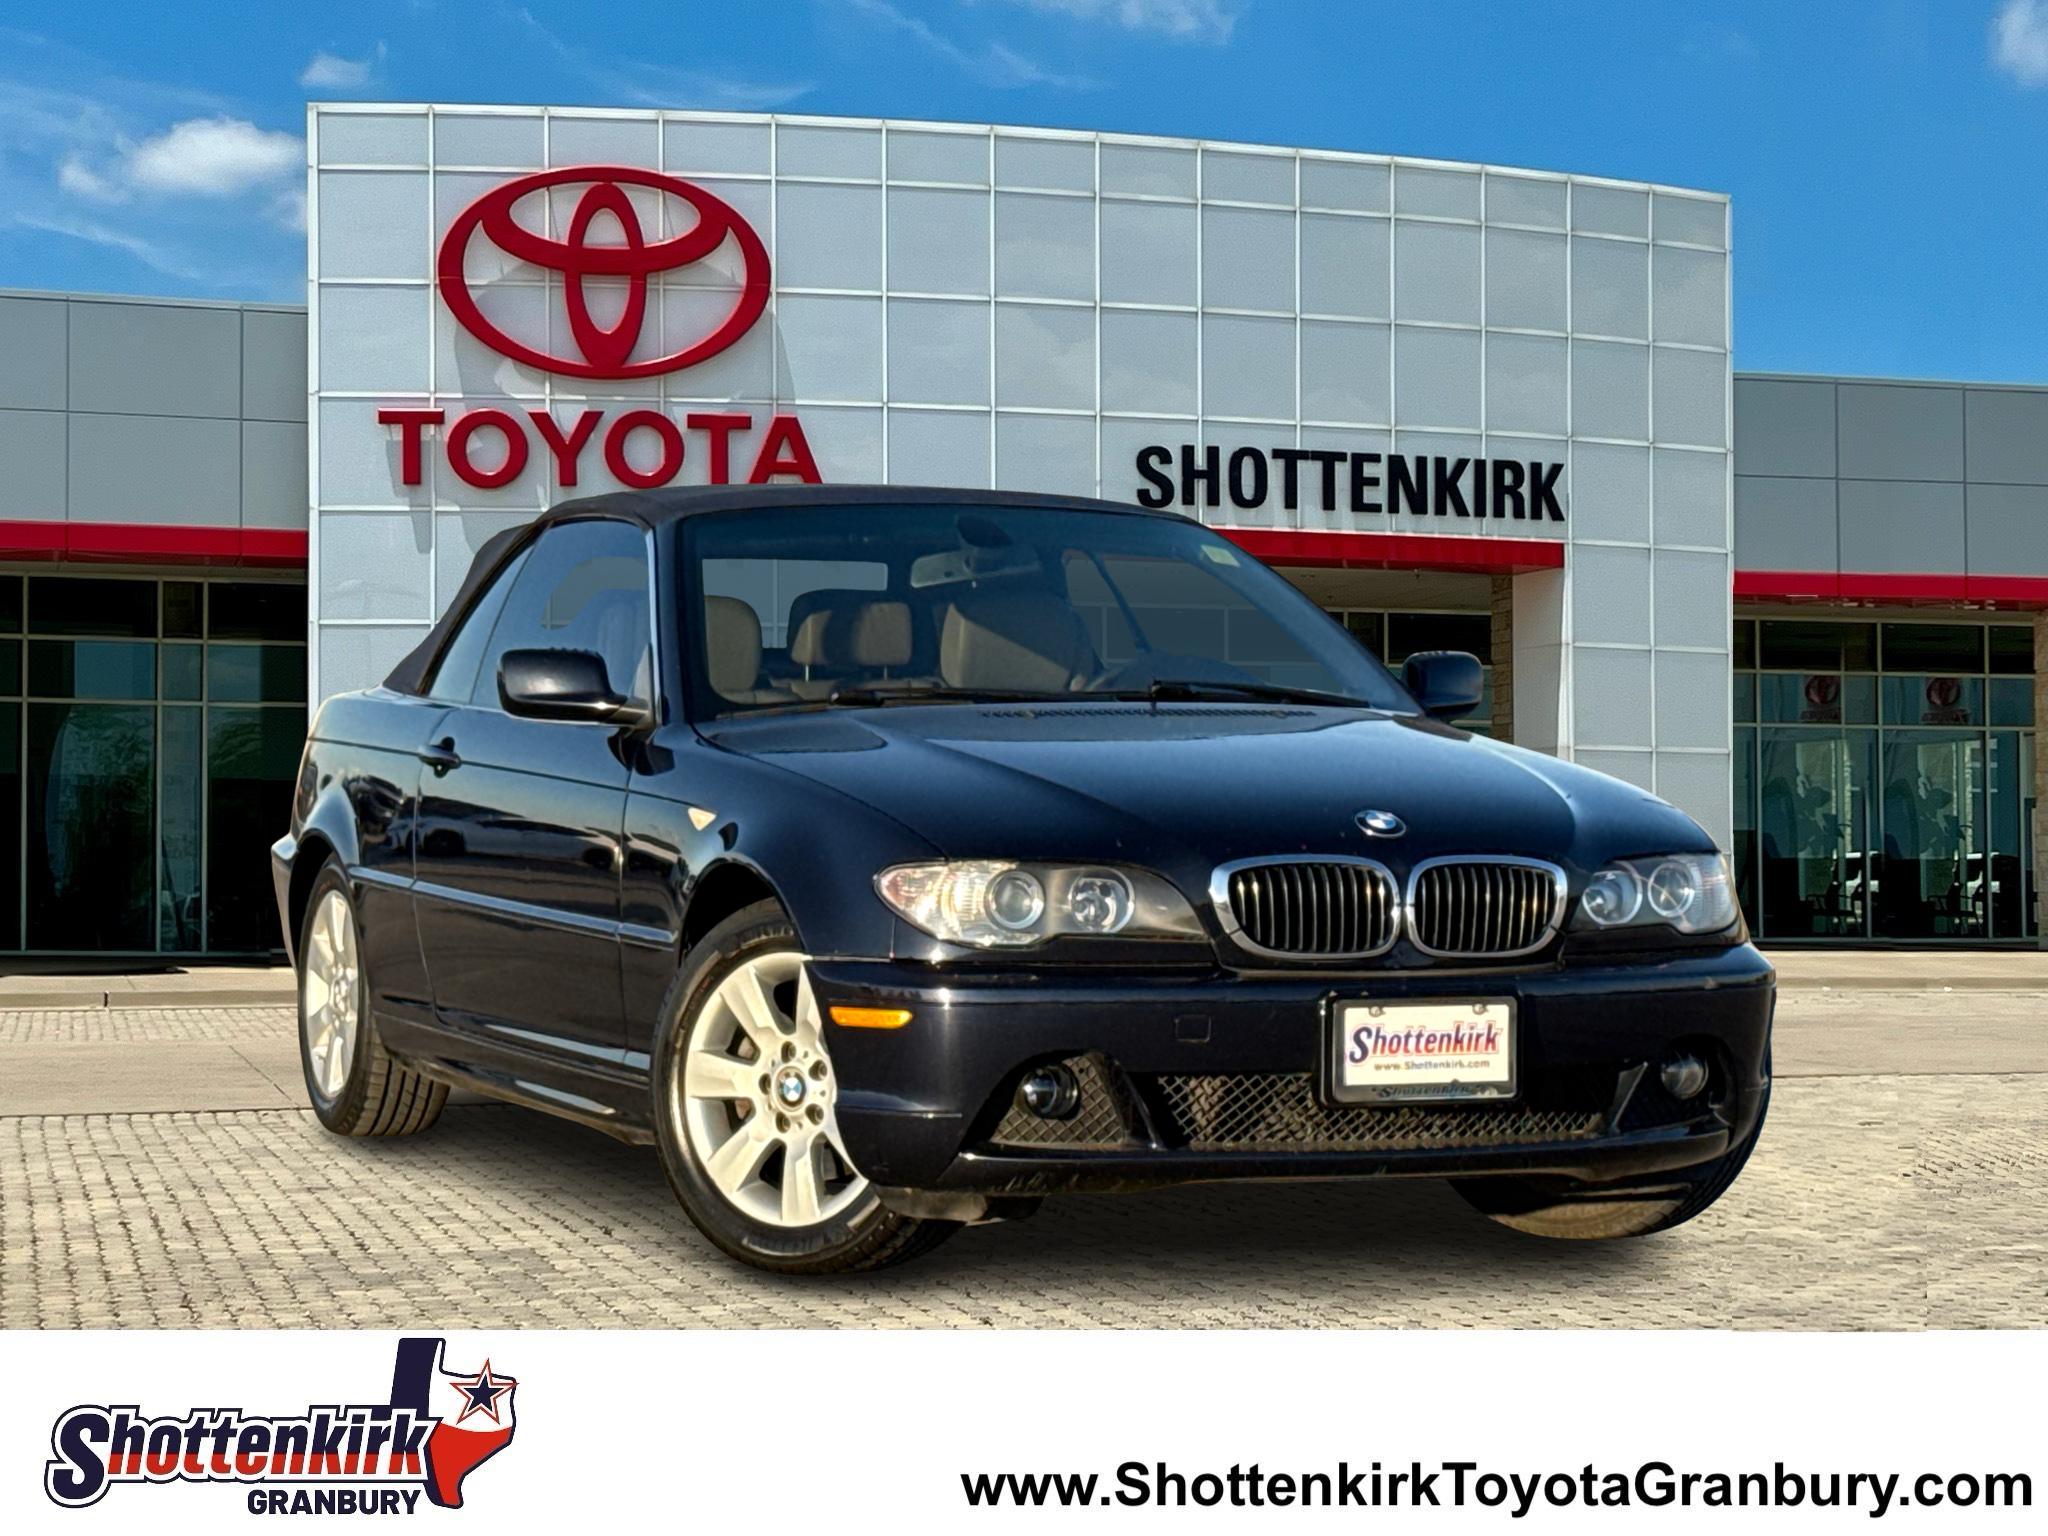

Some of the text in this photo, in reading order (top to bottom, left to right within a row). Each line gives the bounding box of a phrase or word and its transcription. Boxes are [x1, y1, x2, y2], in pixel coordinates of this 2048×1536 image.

[378, 407, 823, 489] TOYOTA
[1136, 445, 1566, 522] SHOTTENKIRK
[1347, 1020, 1500, 1064] Shottenkirk
[1374, 1058, 1490, 1071] www.Shottenkirk.com
